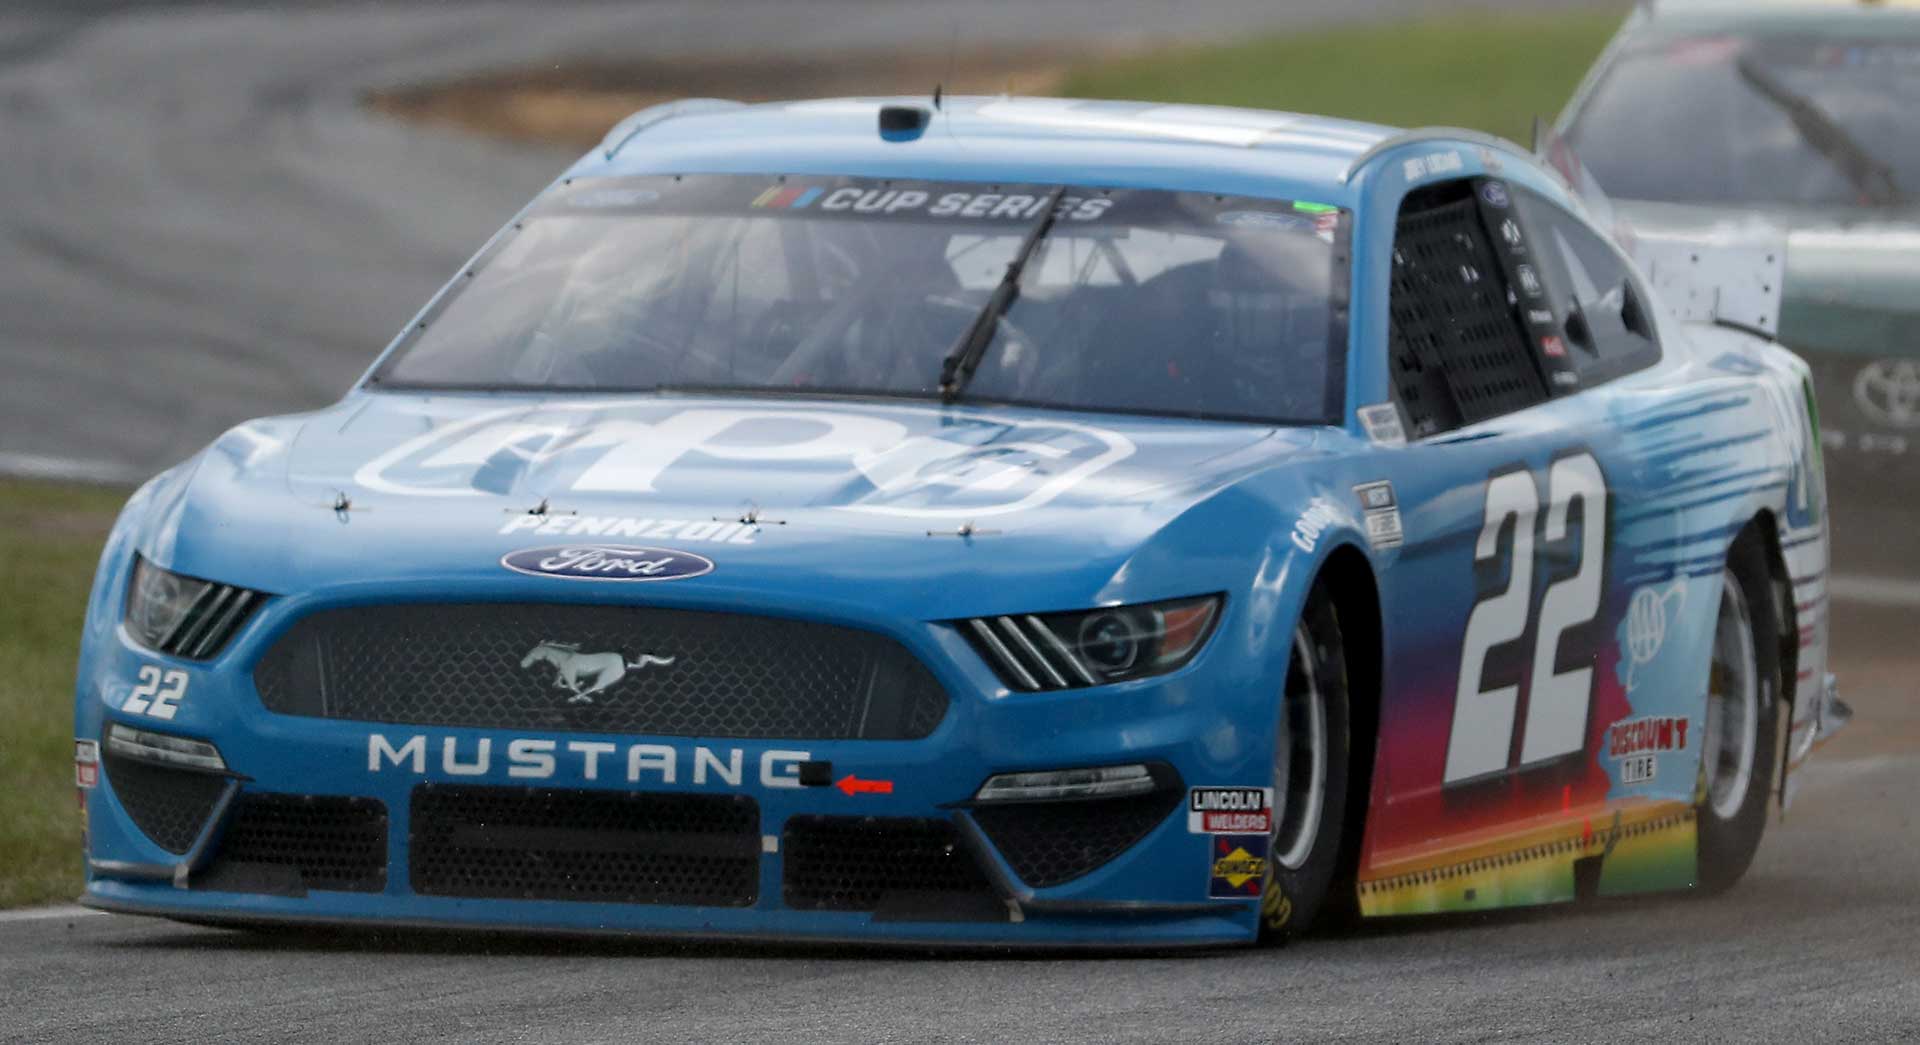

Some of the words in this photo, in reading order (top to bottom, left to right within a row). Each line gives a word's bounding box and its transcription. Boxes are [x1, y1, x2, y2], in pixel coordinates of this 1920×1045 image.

[821, 187, 928, 213] CUP
[929, 192, 1113, 220] SERIES
[499, 515, 760, 545] PENNZOIL
[540, 549, 673, 576] Ford
[1443, 452, 1607, 784] 22
[121, 665, 190, 720] 22
[1609, 717, 1689, 756] DISCOUNT
[368, 733, 810, 789] MUSTANG
[1622, 758, 1655, 782] TIRE
[1193, 791, 1262, 810] LINCOLN
[1208, 814, 1268, 830] WELDERS
